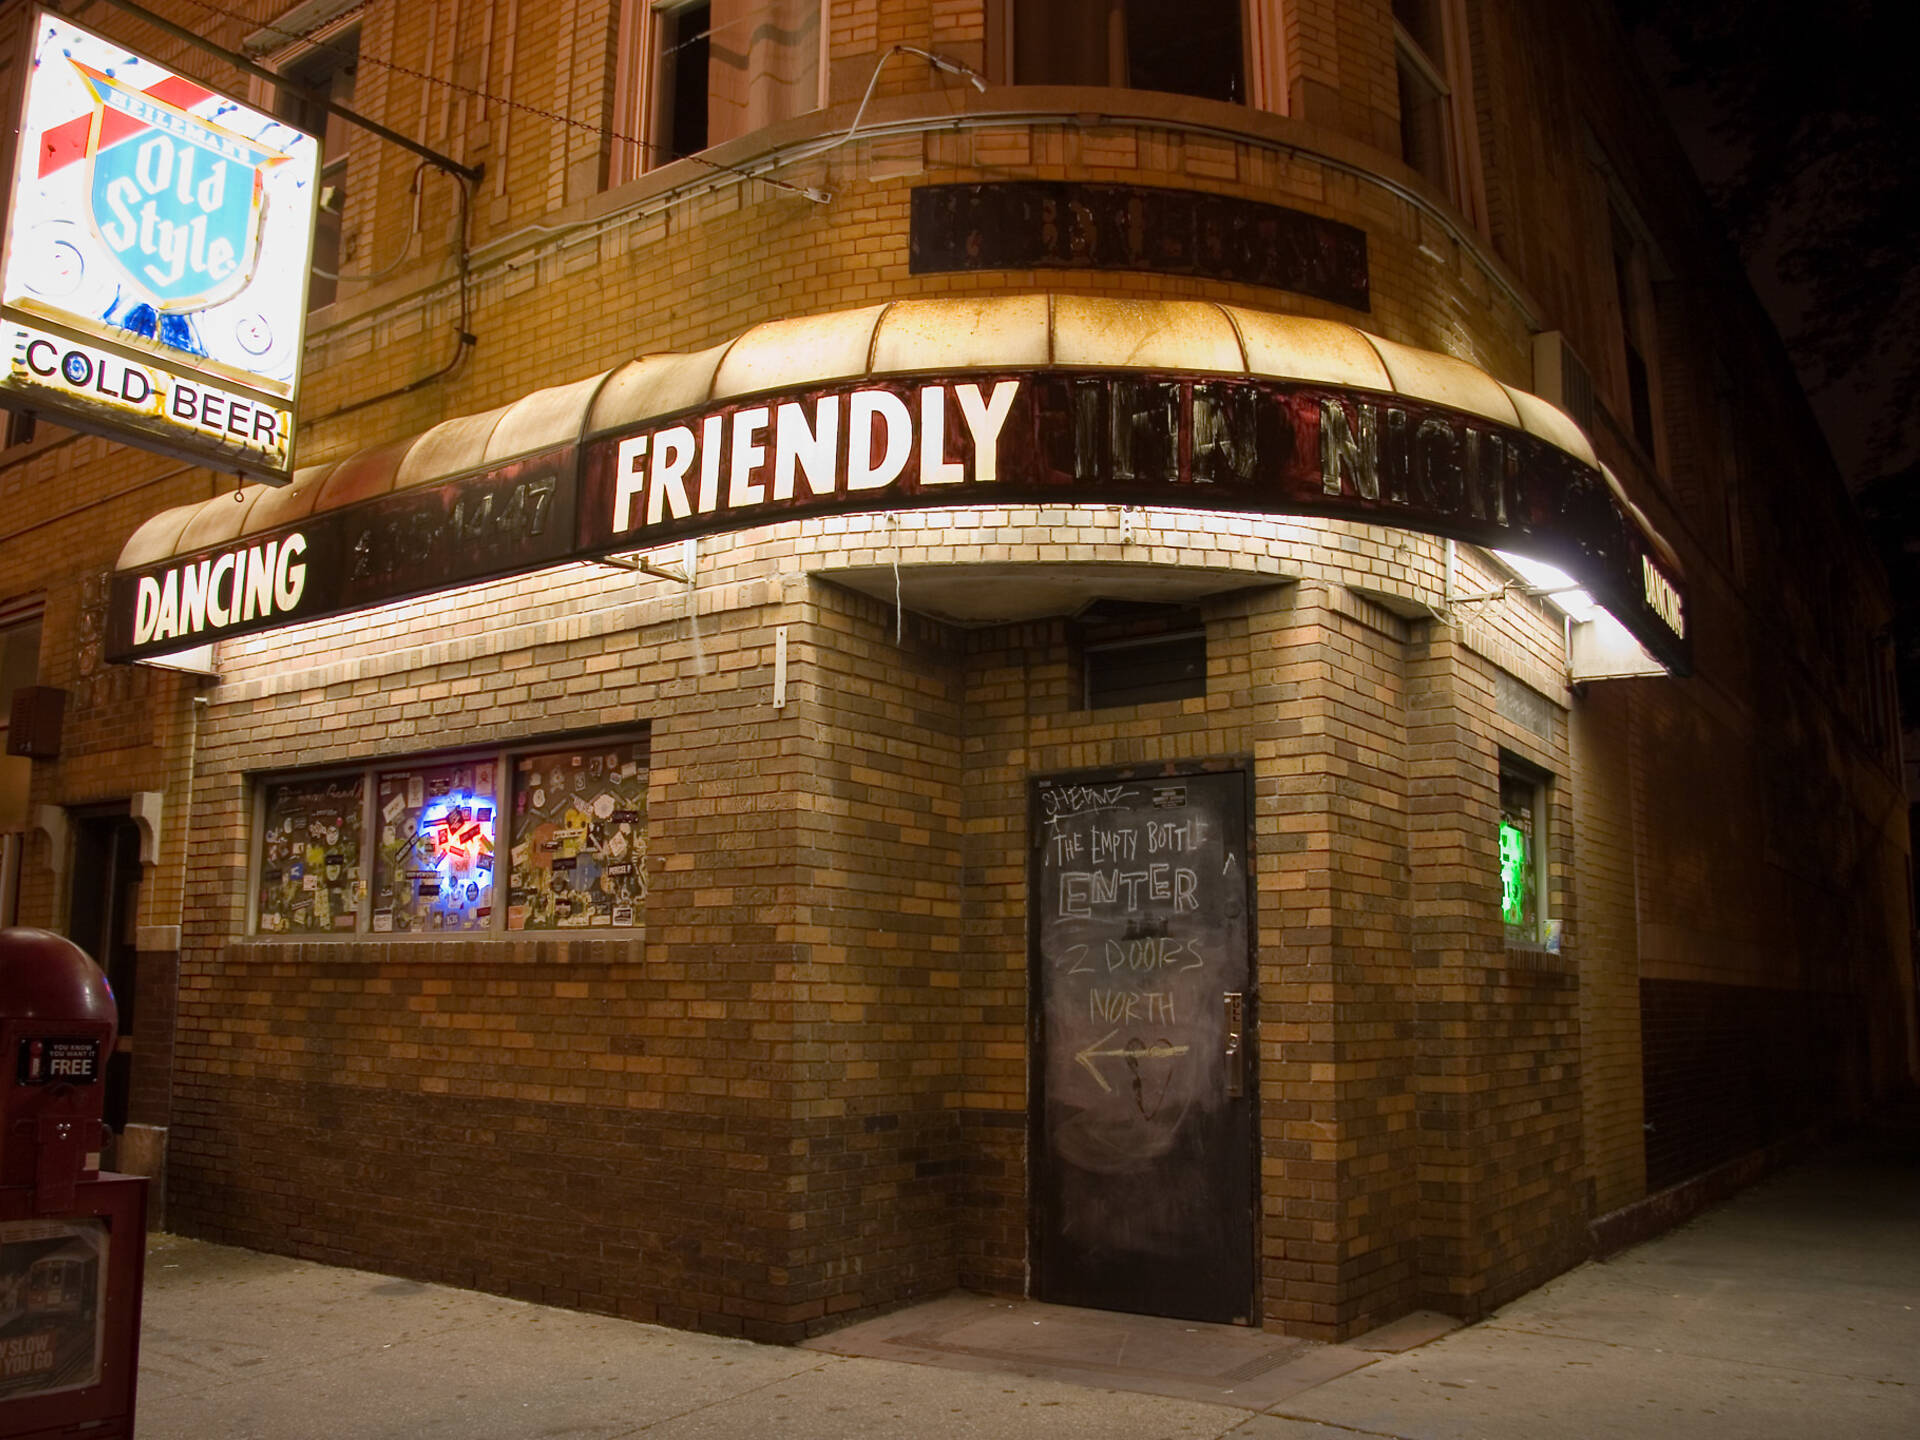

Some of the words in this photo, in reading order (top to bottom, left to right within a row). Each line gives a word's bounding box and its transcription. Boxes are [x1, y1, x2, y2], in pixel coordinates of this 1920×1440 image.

[135, 135, 228, 213] Old
[26, 339, 151, 404] COLD
[172, 384, 277, 446] BEER
[612, 381, 1020, 533] FRIENDLY
[133, 533, 307, 647] DANCING
[1053, 832, 1084, 866] THE
[1091, 825, 1138, 864] EMPTY
[1059, 863, 1199, 918] ENTER
[1056, 944, 1096, 975] 2
[1105, 937, 1204, 974] DOORS
[1089, 988, 1176, 1025] NORTH
[50, 1059, 93, 1075] FREE
[4, 1355, 32, 1375] YOU
[34, 1351, 53, 1369] GO
[9, 1334, 49, 1357] SLOW
